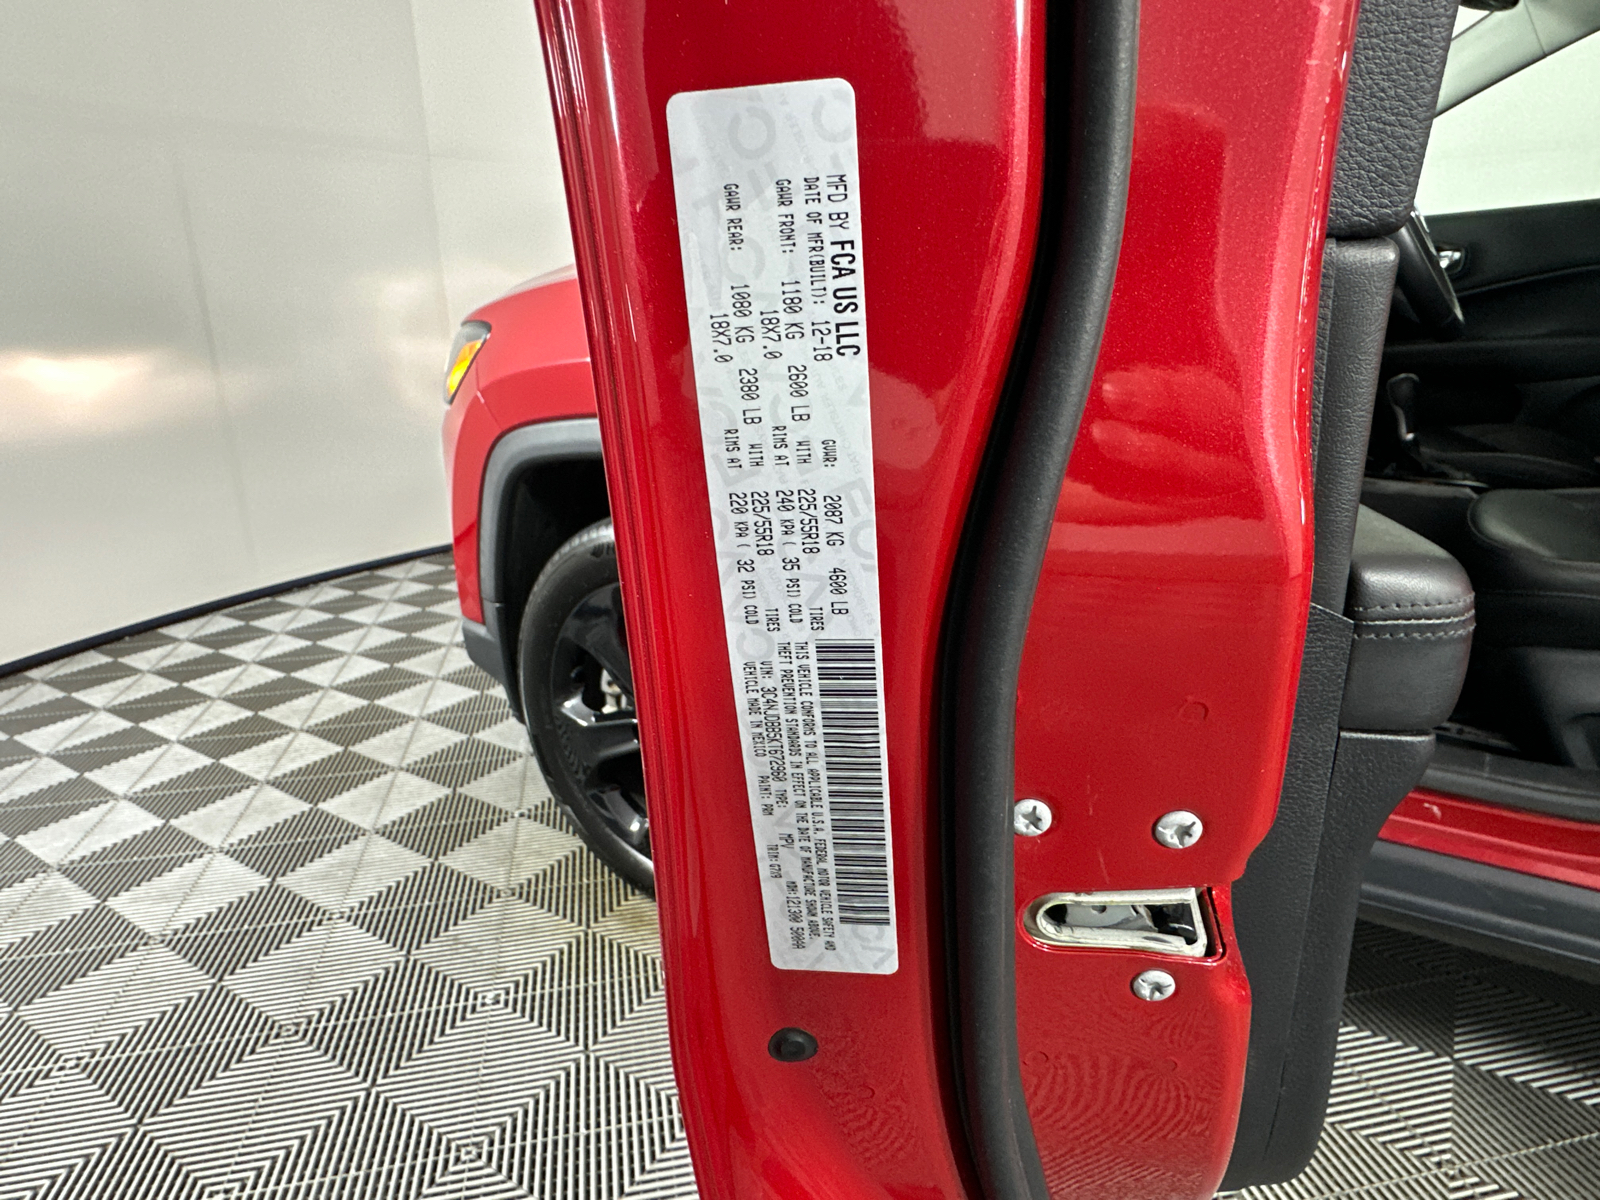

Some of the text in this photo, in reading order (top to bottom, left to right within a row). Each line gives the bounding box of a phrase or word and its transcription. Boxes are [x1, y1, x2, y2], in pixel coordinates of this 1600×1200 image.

[803, 176, 822, 205] DATE
[805, 211, 823, 225] OF
[807, 232, 827, 305] MFR(BUILT):
[826, 173, 861, 357] MFD BY FCA US LLC
[709, 313, 734, 363] 18X7.0
[759, 309, 783, 360] 18X7.0
[811, 320, 833, 362] 12-18
[723, 183, 781, 632] GAWR REAR: 1080 KG 2380 LB WITH 225/55R18 TIRES
[775, 178, 825, 631] GAWR FRONT: 1180 KG 2600 LB WITH 225/55R18 TIRES
[723, 428, 741, 453] RIMS
[771, 425, 789, 450] RIMS
[726, 457, 743, 469] AT
[774, 454, 790, 466] AT
[821, 439, 838, 468] GVWR:
[728, 492, 749, 515] 220
[775, 489, 796, 512] 240
[823, 494, 844, 525] 2087
[734, 521, 750, 538] KPA
[779, 518, 795, 536] KPA
[825, 531, 845, 547] KG
[736, 558, 756, 573] 32
[781, 556, 801, 571] 35
[740, 579, 757, 600] PSI)
[785, 578, 801, 598] PSI)
[828, 567, 848, 595] 4600
[743, 604, 760, 625] COLD
[787, 603, 804, 624] COLD
[830, 601, 850, 615] LB
[742, 661, 760, 694] VEHICLE
[759, 660, 774, 679] VIN:
[747, 697, 762, 716] MADE
[749, 720, 763, 729] IN
[760, 686, 788, 782] 3C4NJDBB5KT672960
[751, 732, 767, 757] MEXICO
[757, 775, 772, 799] PAINT:
[775, 789, 789, 808] TYPE:
[777, 641, 821, 940] THEFT PREVENTION STANDARDS IN EFFECT ON THE DATE OF MANUFACTURE SHOWN ABOVE.
[794, 641, 837, 951] THIS VEHICLE CONFORMS TO ALL APPLICABLE U.S.A. FEDERAL MOTOR VEHICLE SAFETY AND
[761, 803, 774, 816] PRM
[778, 833, 795, 849] MPV
